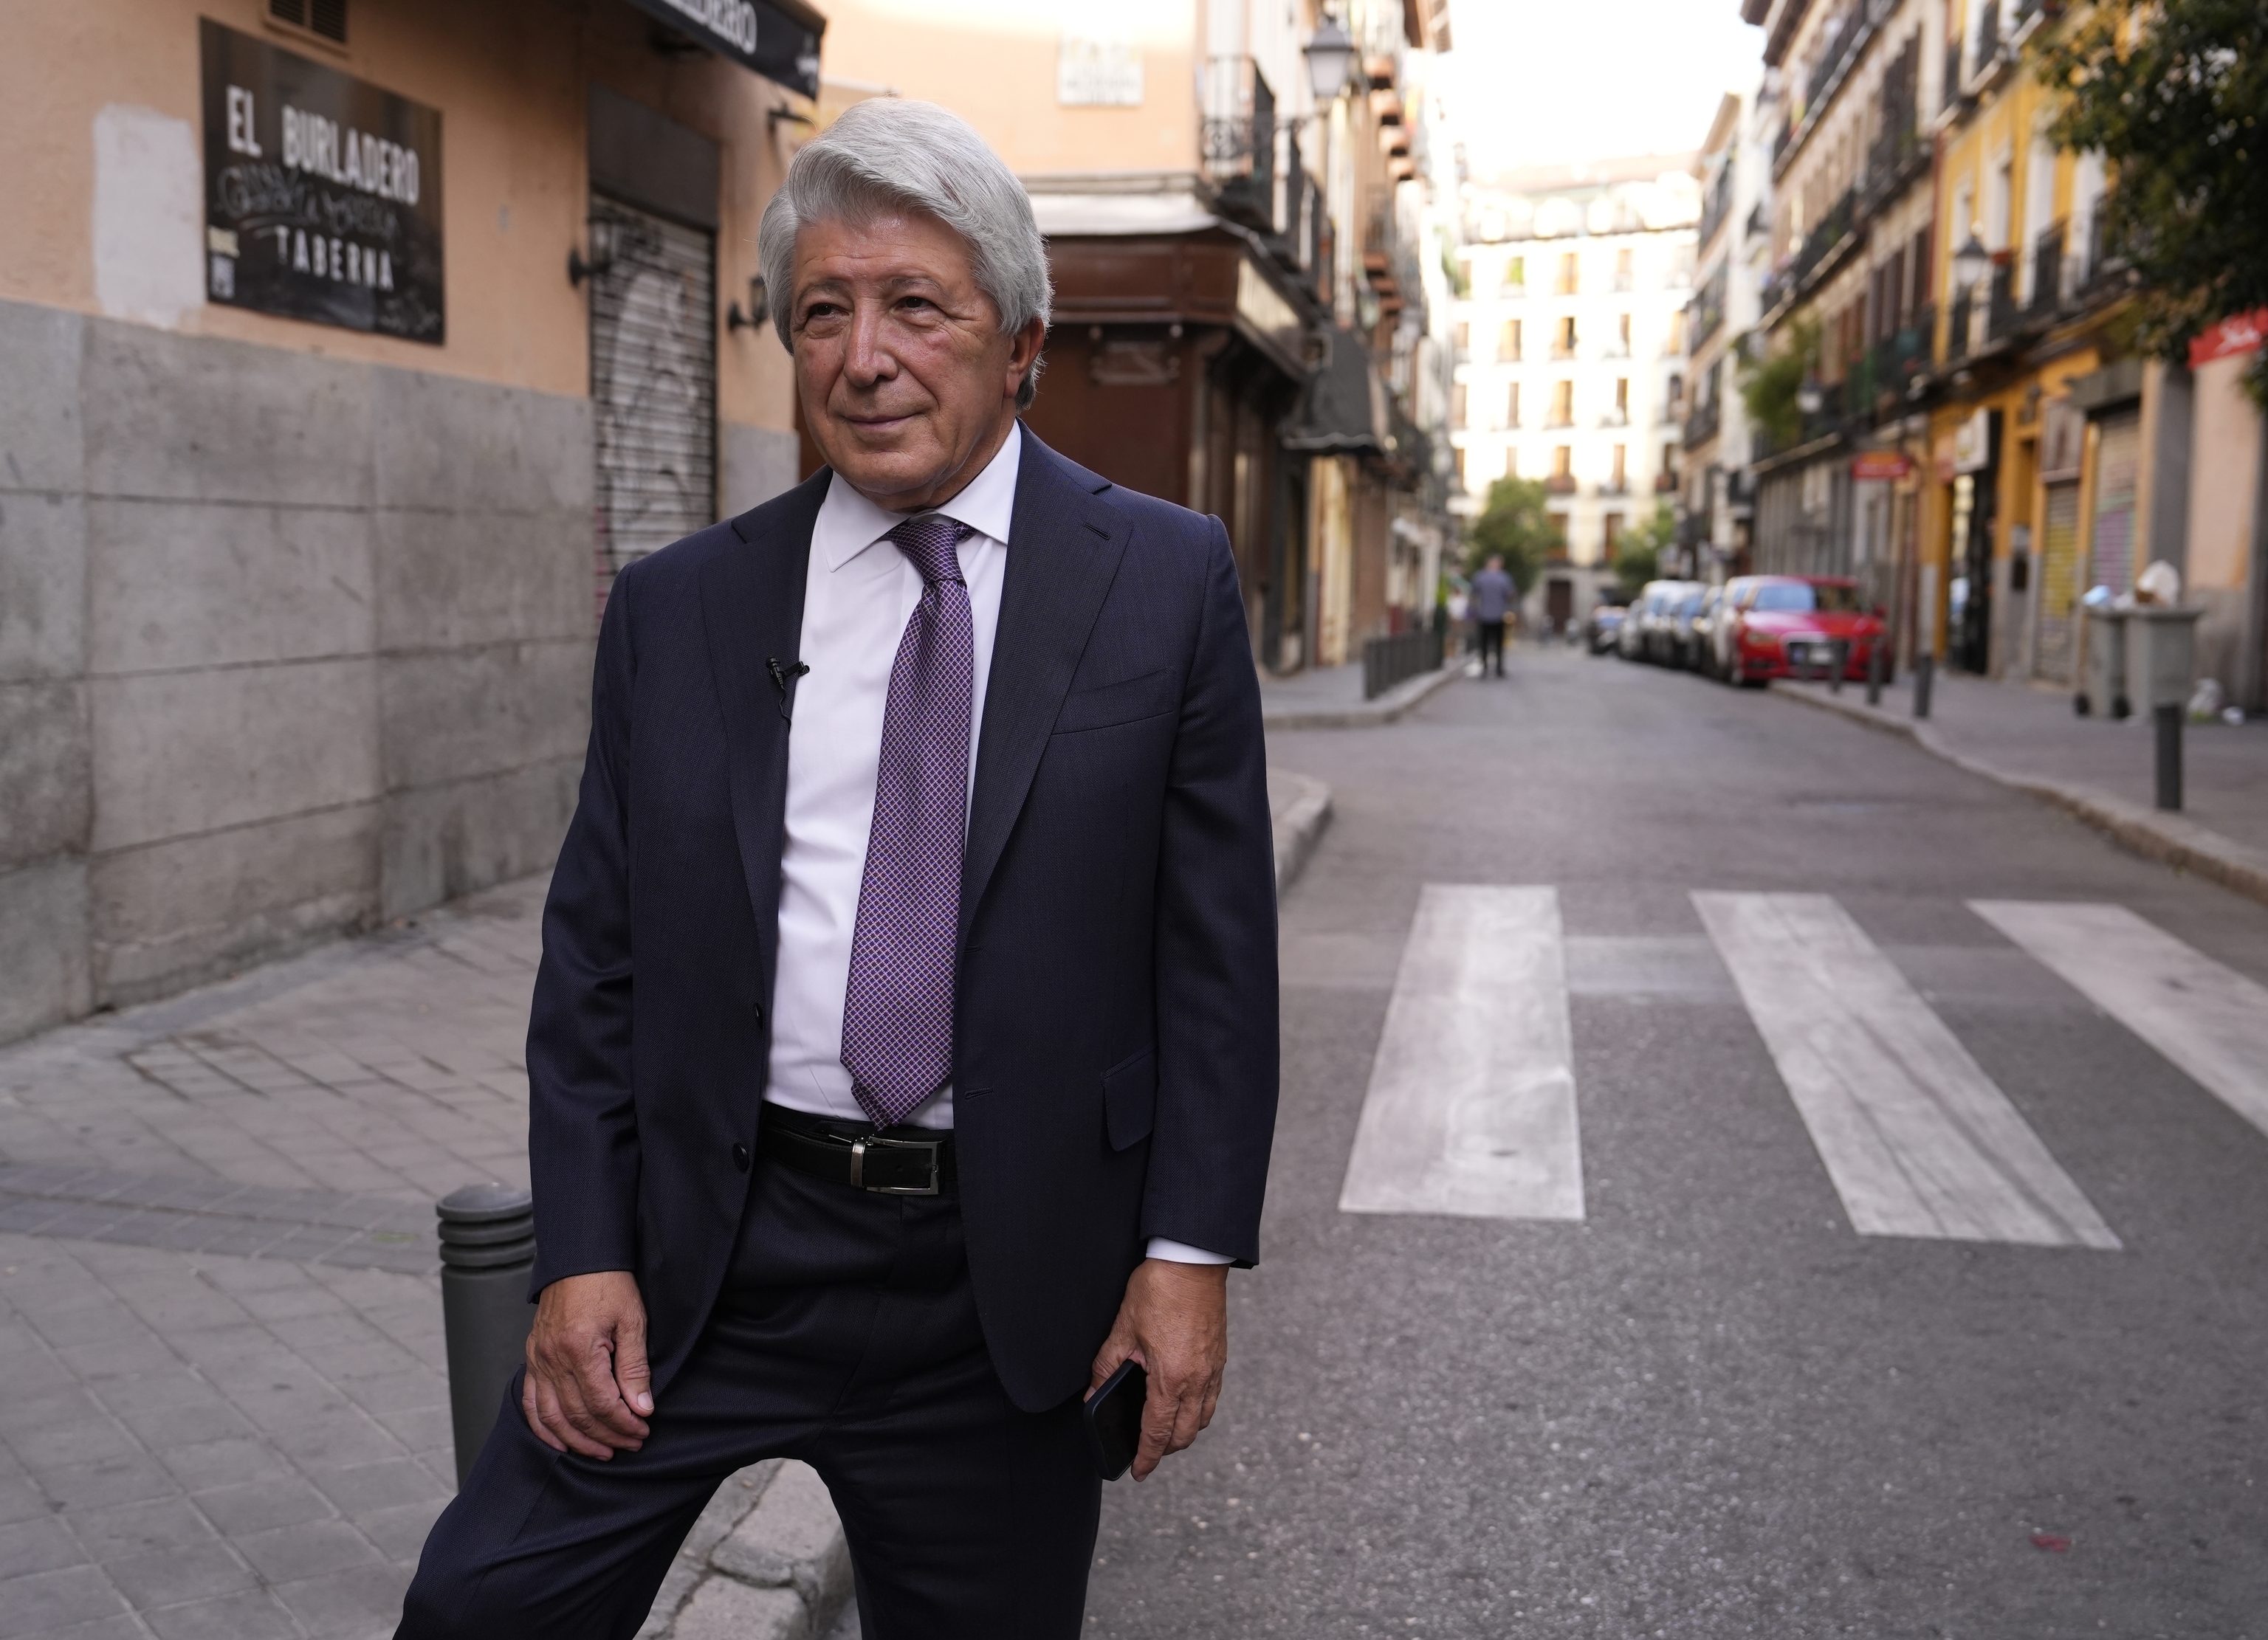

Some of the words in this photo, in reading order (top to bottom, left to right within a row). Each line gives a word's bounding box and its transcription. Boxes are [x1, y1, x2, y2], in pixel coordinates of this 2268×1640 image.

[226, 85, 262, 157] EL
[282, 105, 419, 206] BURLADERO
[275, 225, 394, 290] TABERNA
